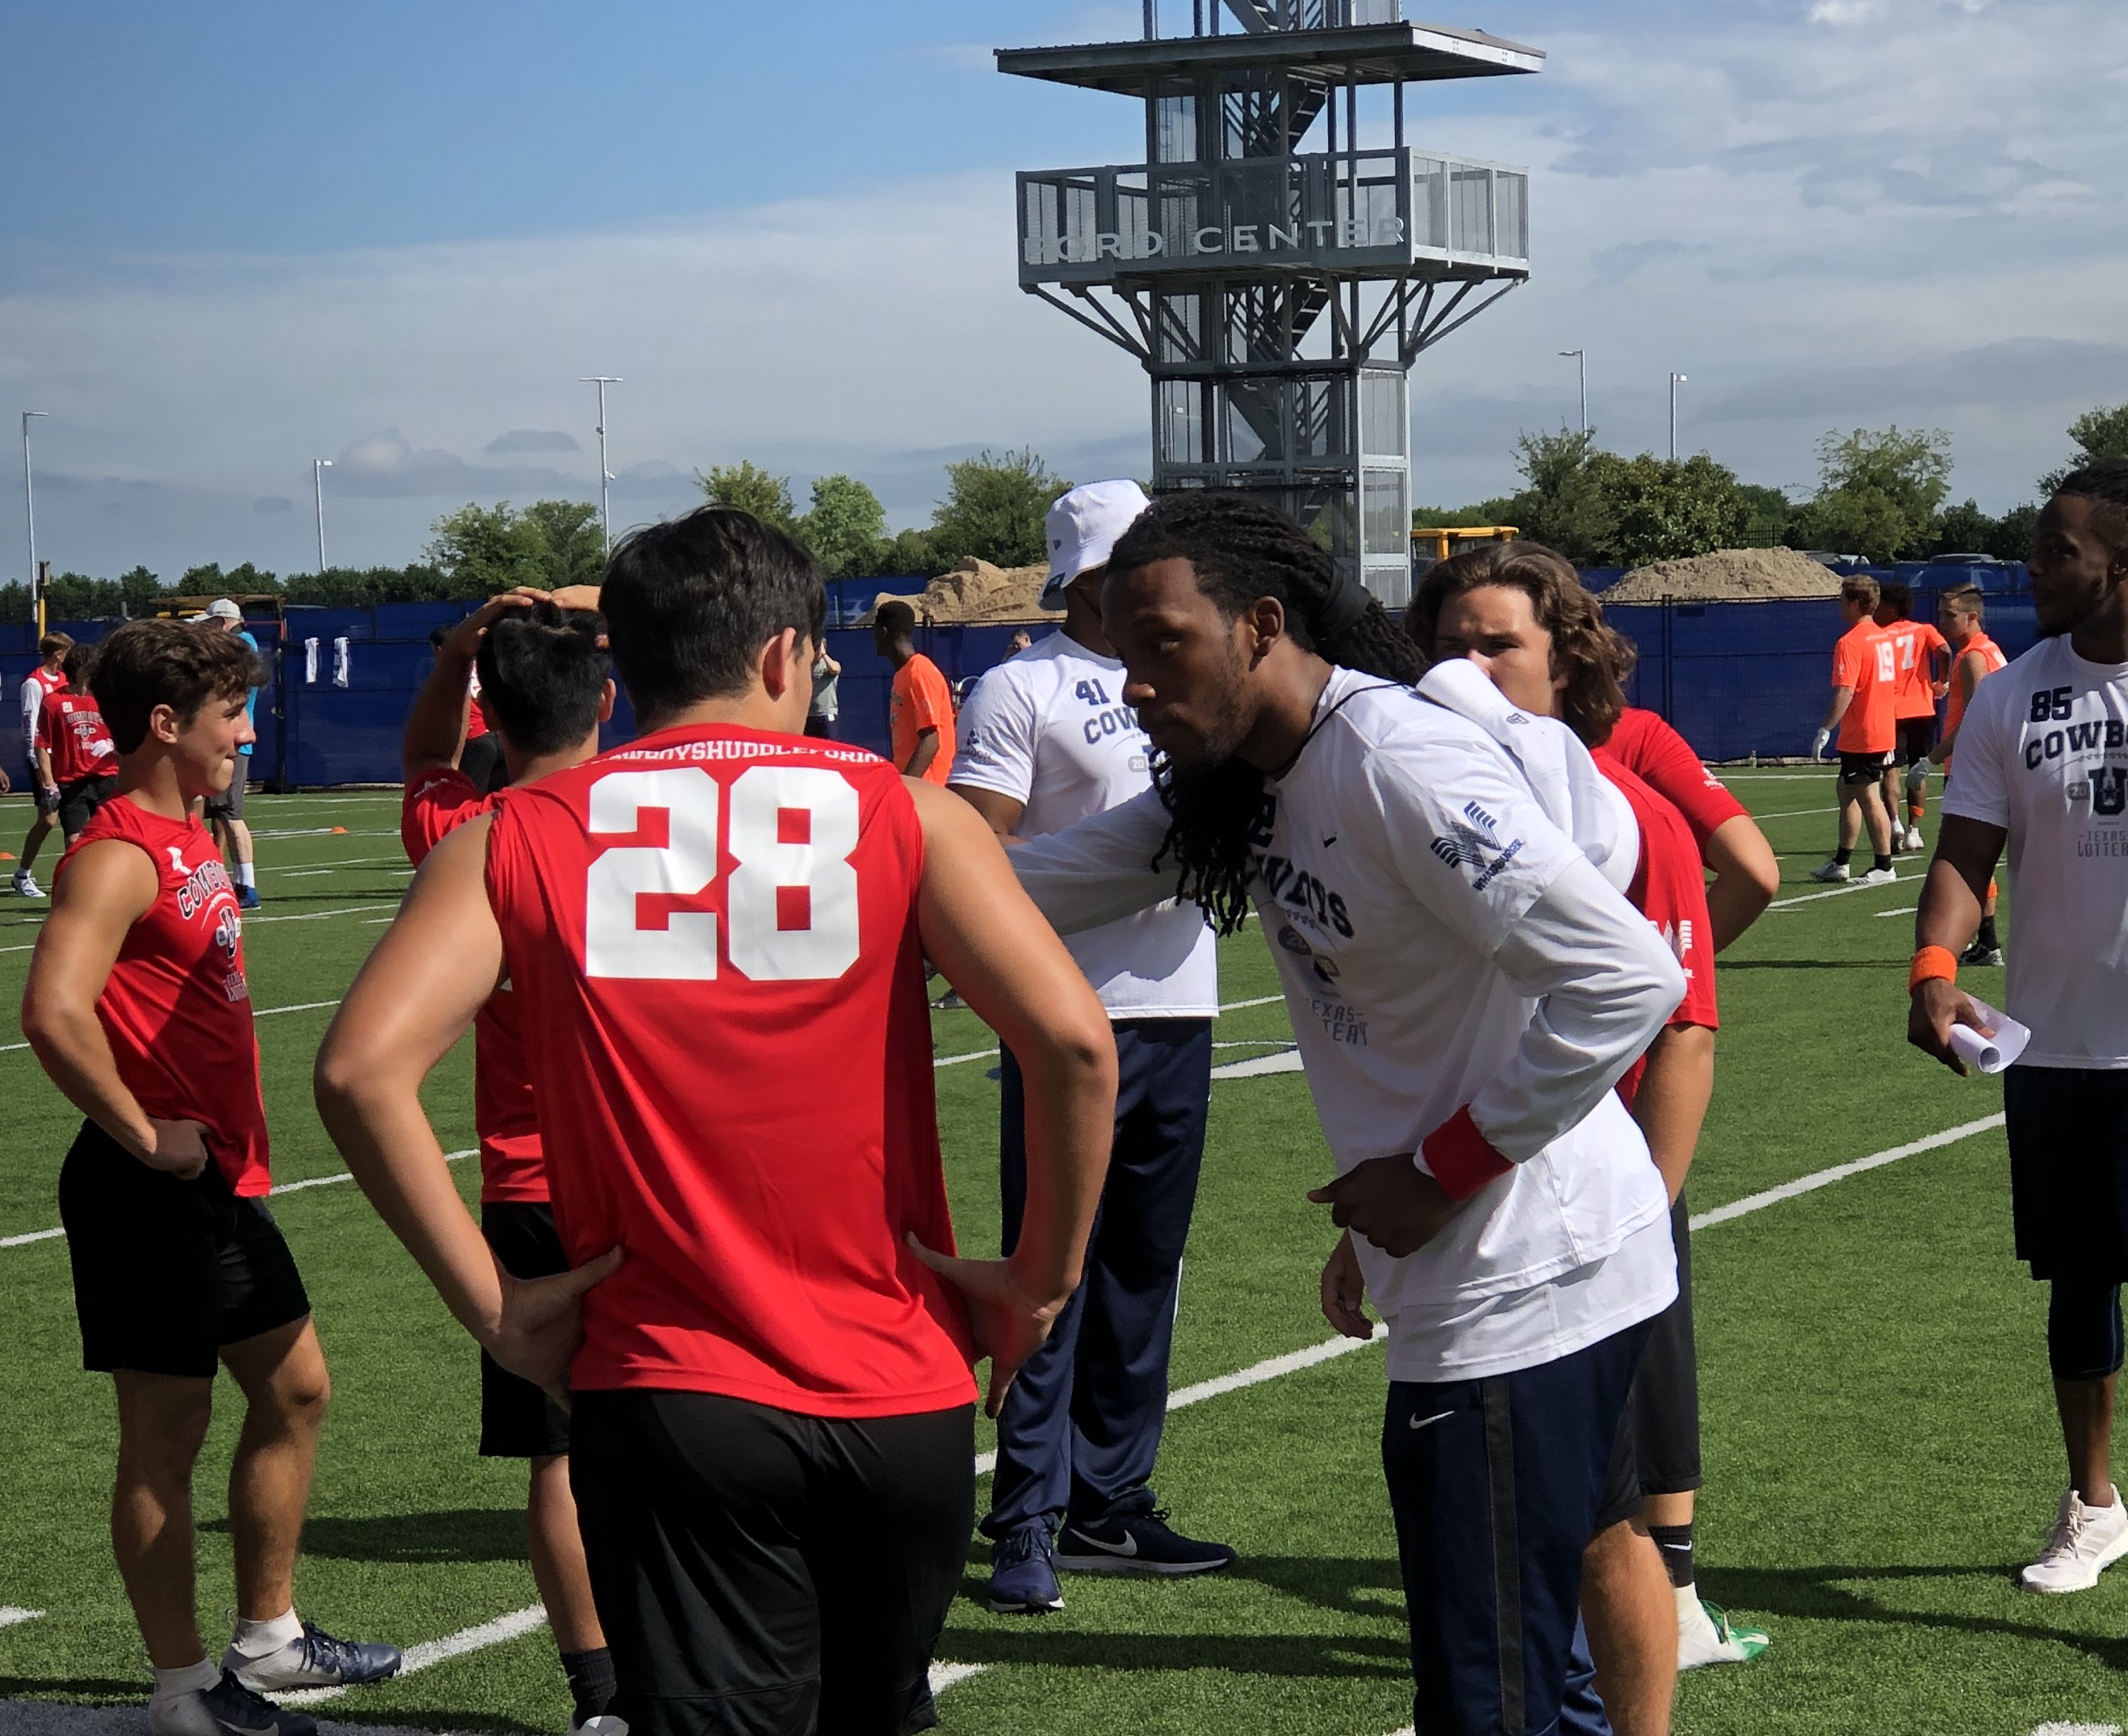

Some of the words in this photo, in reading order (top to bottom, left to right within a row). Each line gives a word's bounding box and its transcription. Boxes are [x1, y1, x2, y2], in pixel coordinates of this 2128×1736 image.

[1025, 231, 1162, 263] FORD
[1194, 216, 1403, 253] CENTER
[1875, 641, 1895, 682] 19
[1075, 678, 1110, 705] 41
[2030, 685, 2072, 722] 85
[2026, 720, 2128, 770] COWB
[586, 766, 860, 981] 28
[1473, 838, 1526, 891] WHATABURGER
